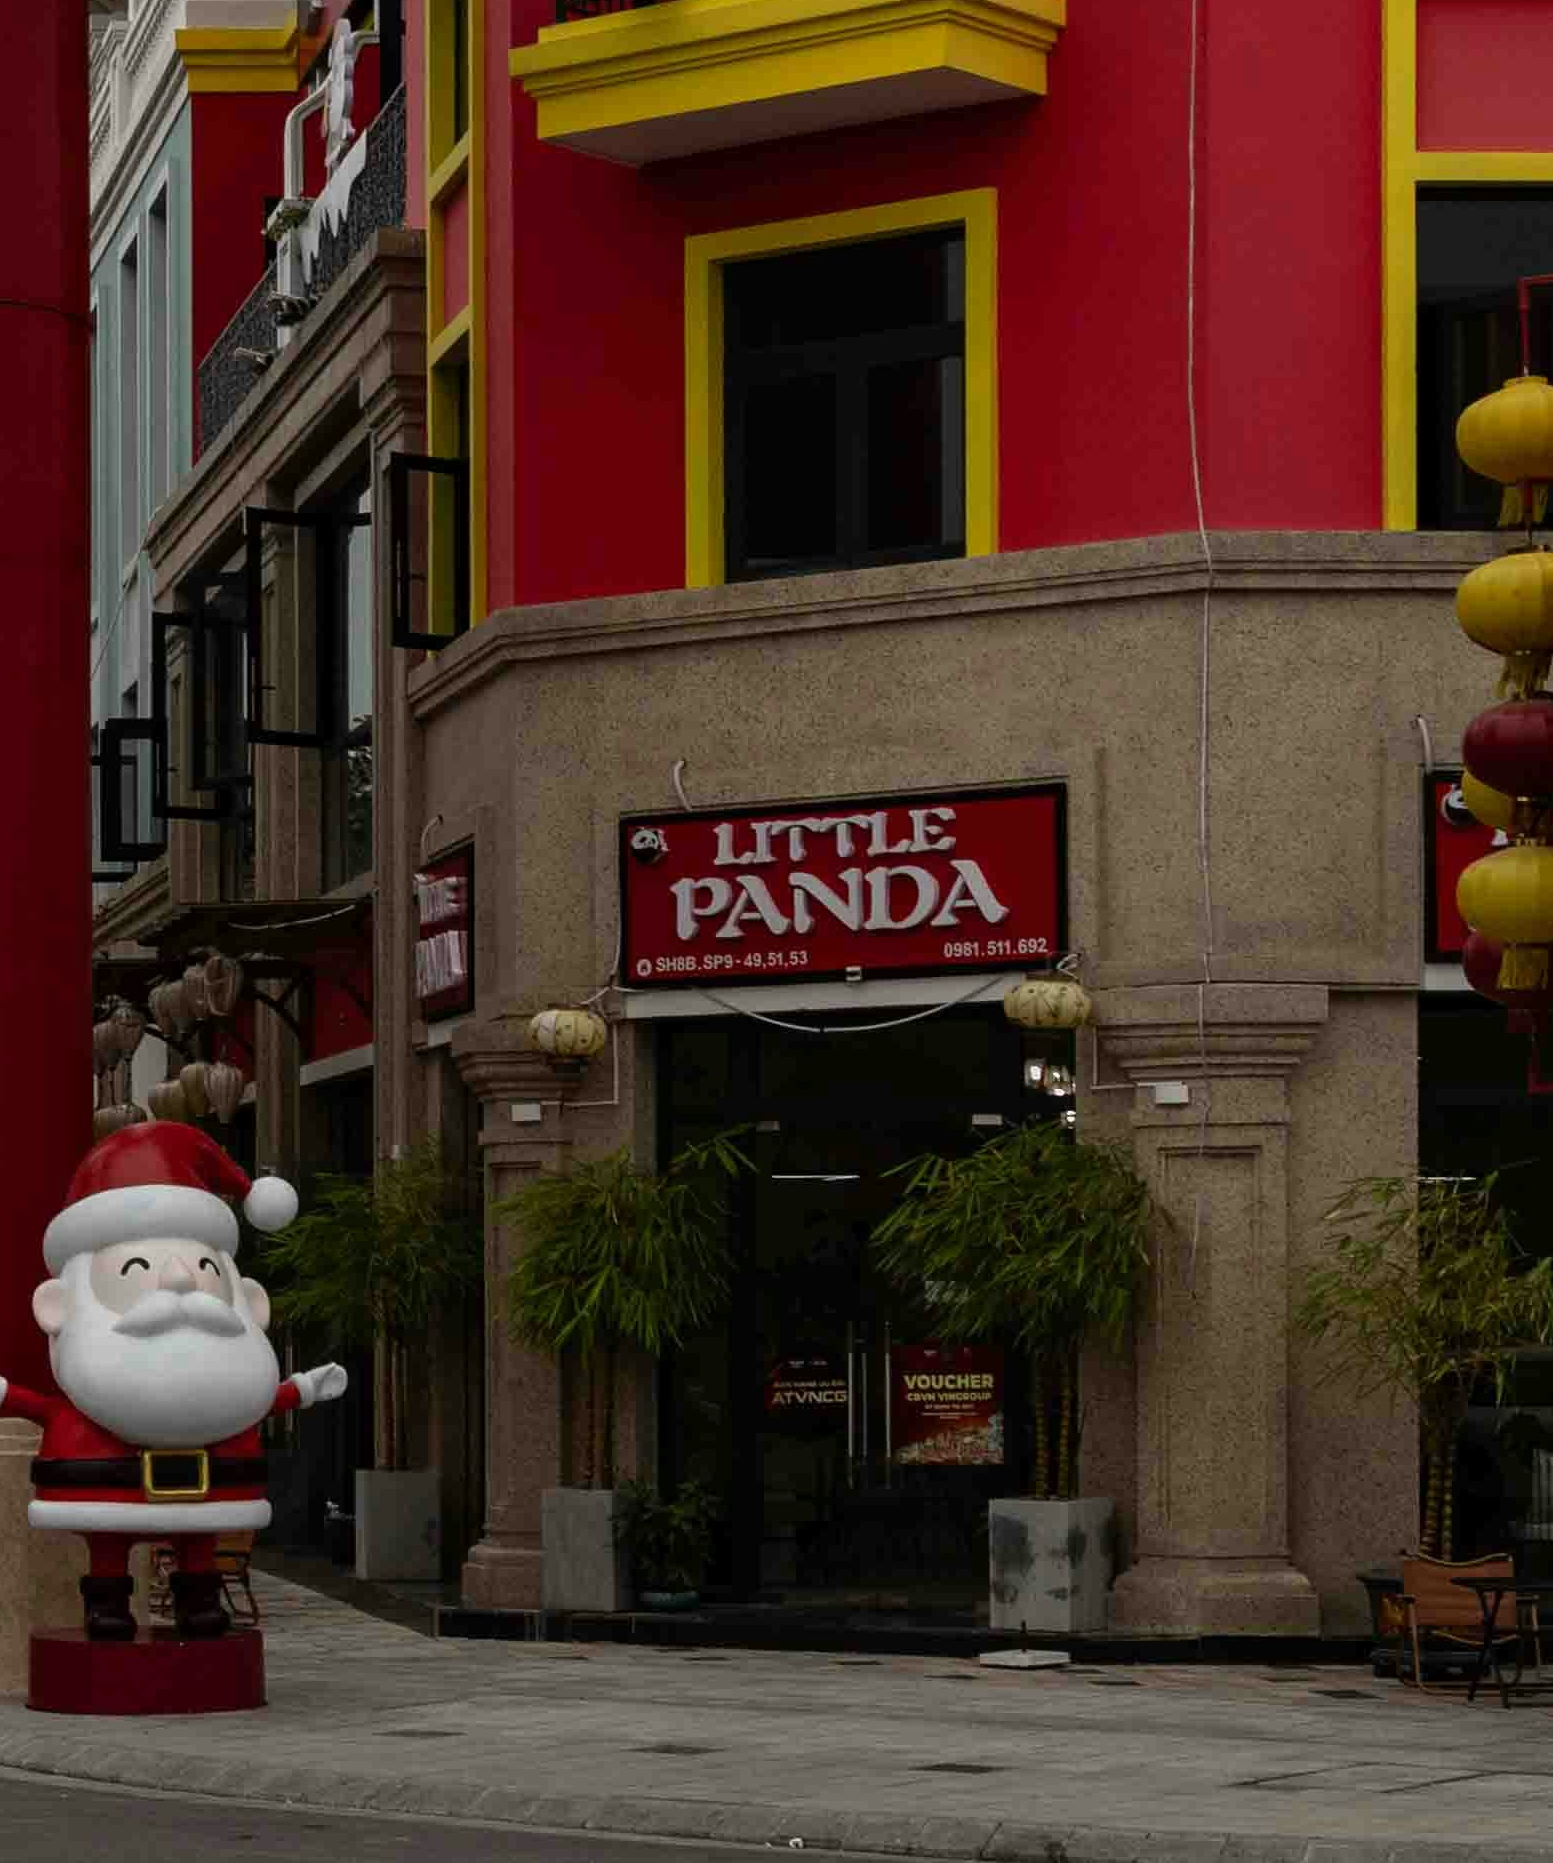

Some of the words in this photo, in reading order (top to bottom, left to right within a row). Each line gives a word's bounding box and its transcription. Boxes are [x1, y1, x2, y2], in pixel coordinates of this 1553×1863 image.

[712, 806, 958, 867] LITTLE
[669, 858, 1010, 942] PANDA
[942, 937, 1049, 960] 0981.511.692
[903, 1374, 994, 1390] VOUCHER
